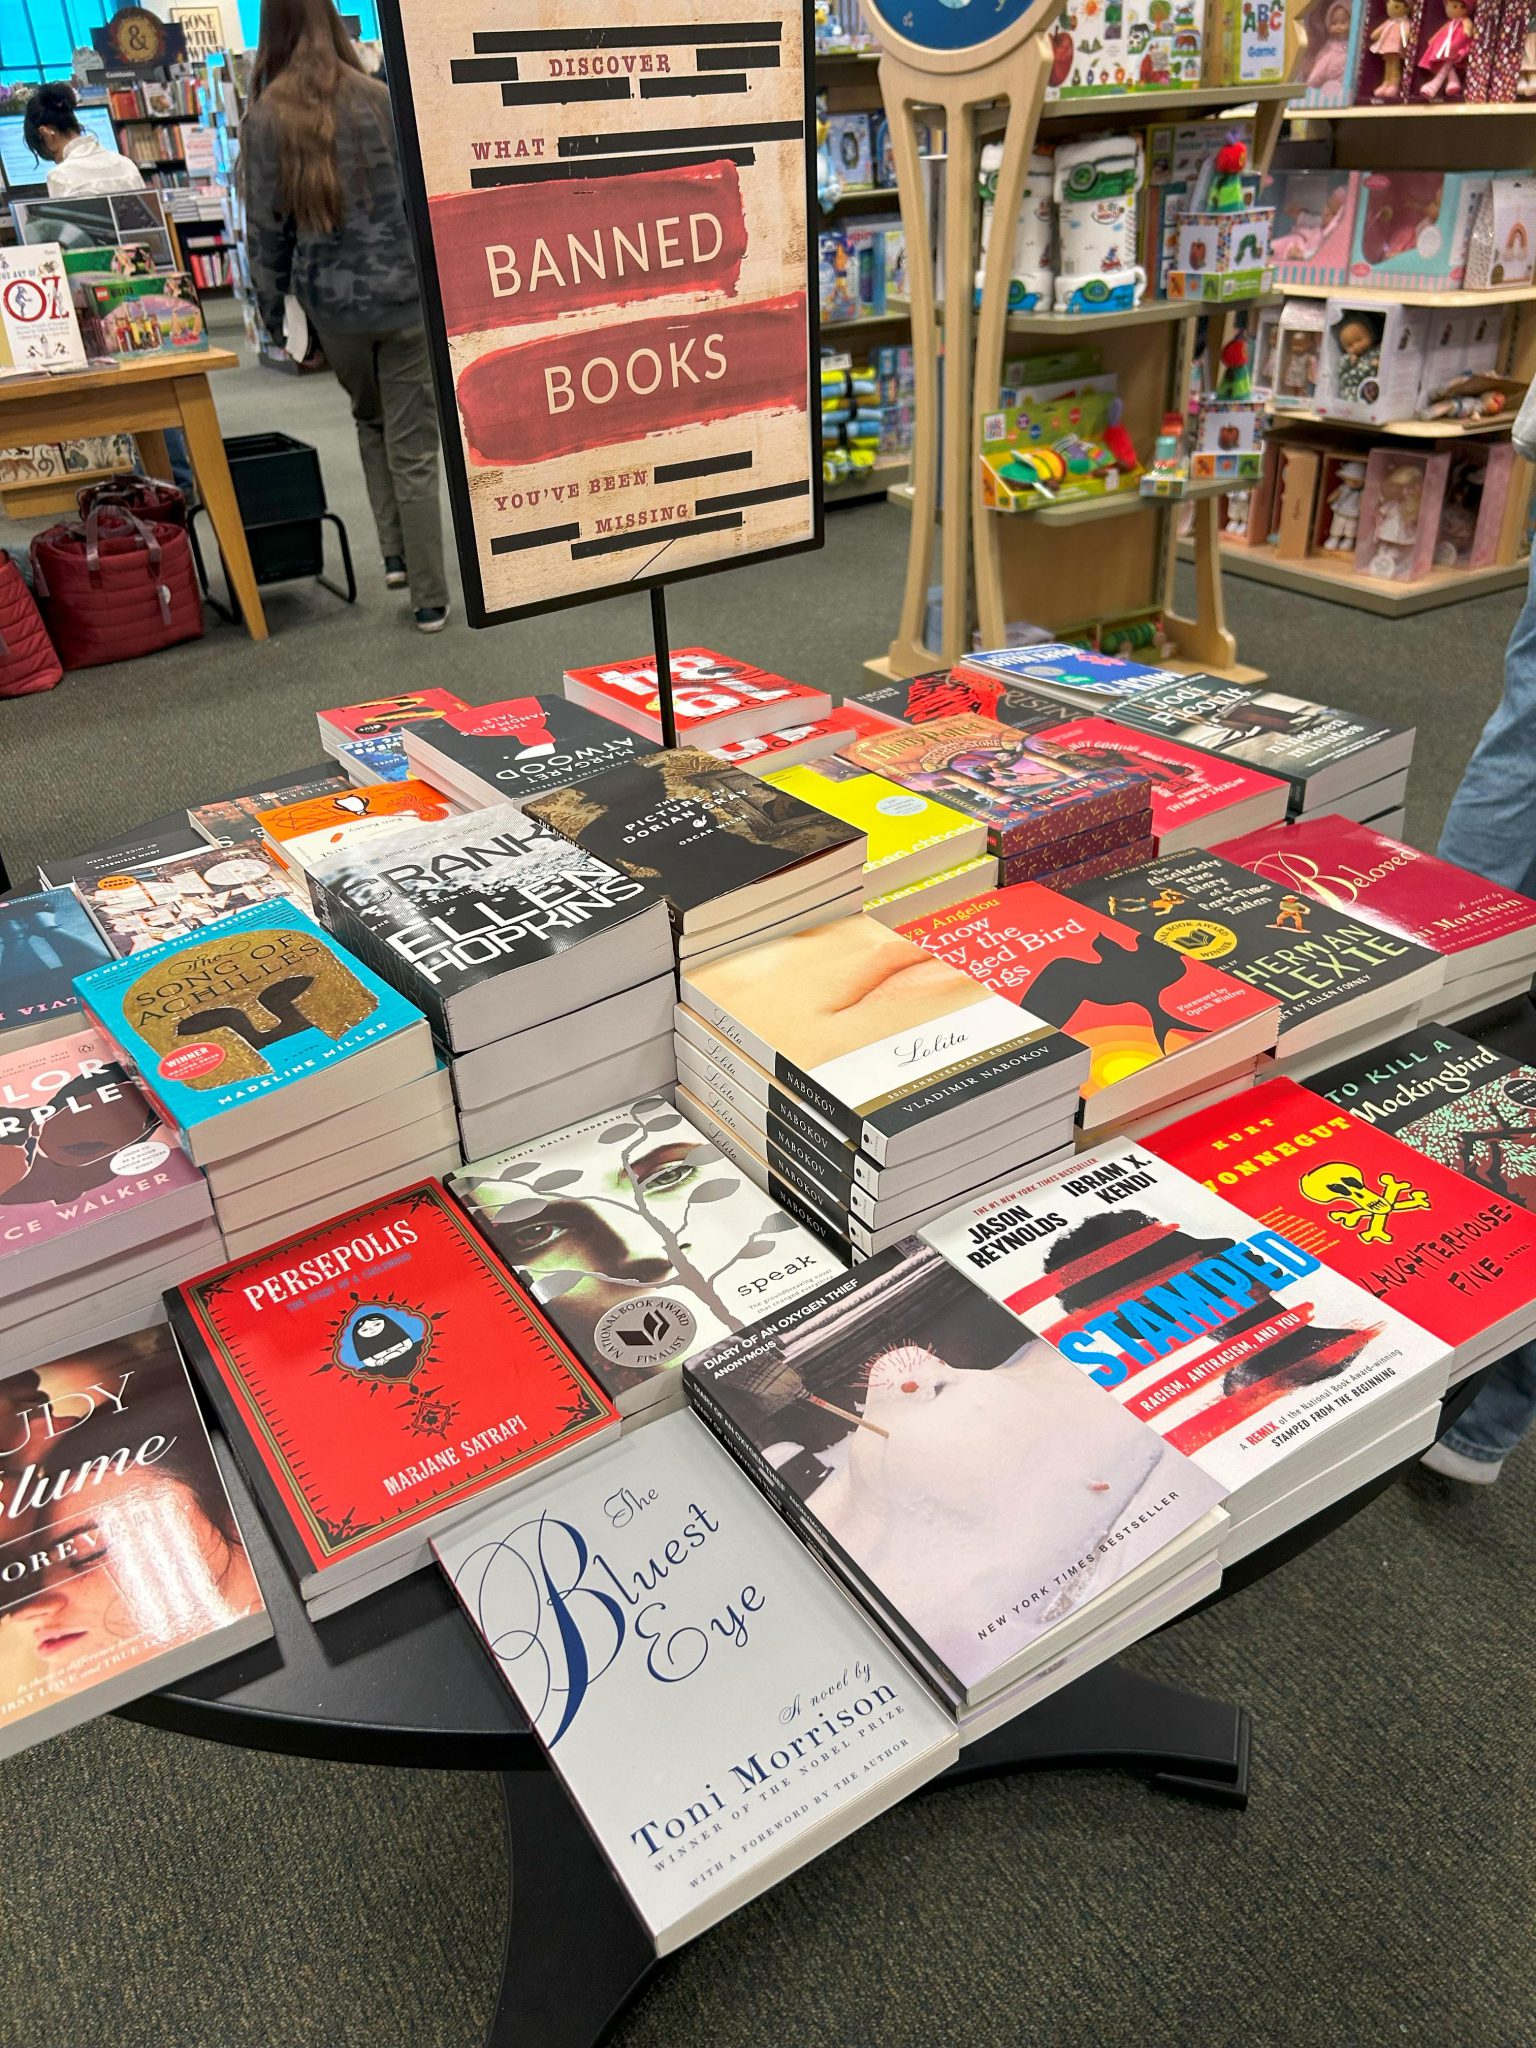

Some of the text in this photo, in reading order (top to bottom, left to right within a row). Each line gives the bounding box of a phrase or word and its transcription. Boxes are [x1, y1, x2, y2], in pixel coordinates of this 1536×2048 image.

[128, 25, 147, 50] &
[550, 54, 670, 77] DISCOVER
[472, 138, 545, 160] WHAT
[484, 213, 723, 298] BANNED
[3, 276, 69, 322] OZ
[544, 333, 728, 415] BOOKS
[494, 470, 648, 512] YOU'VE BEEN
[595, 503, 689, 534] MISSING
[481, 713, 516, 724] TALE
[1145, 685, 1211, 712] Jodi
[1148, 686, 1252, 728] Picoult
[459, 711, 551, 737] HANDMAID'S
[499, 722, 527, 732] THE
[1265, 718, 1349, 755] nineteen
[1286, 723, 1365, 759] minutes
[495, 737, 633, 780] ATWOOD
[526, 748, 635, 783] MARGARET
[622, 788, 750, 845] DORIAN GRAY
[624, 796, 704, 832] PICTURE
[654, 796, 680, 809] THE
[678, 812, 749, 847] OSCAR WILDE
[94, 849, 160, 870] JOHN STEINBECK
[1146, 858, 1224, 887] Absolutely
[1175, 871, 1213, 886] True
[1241, 848, 1421, 911] Beloved
[1189, 878, 1229, 895] Diary
[1198, 883, 1274, 912] Part-Time
[1222, 895, 1273, 916] Indian
[385, 858, 621, 963] ELLEN
[415, 873, 646, 985] HOPKINS
[931, 897, 1001, 930] Angelou
[1431, 899, 1523, 931] Morrison
[103, 960, 129, 974] NEW
[134, 946, 167, 961] YORK
[171, 931, 207, 947] TIMES
[211, 900, 283, 932] BESTSELLER
[913, 915, 991, 952] Know
[986, 925, 1021, 949] the
[1021, 918, 1086, 953] Bird
[1231, 923, 1375, 985] HERMAN
[135, 933, 295, 1007] SONG OF
[168, 940, 252, 977] The
[1263, 937, 1410, 1001] LEXIE
[136, 941, 322, 1029] ACHILLES
[1176, 987, 1228, 1014] Foreword by
[1185, 988, 1246, 1018] Oprah Winfrey
[1307, 974, 1372, 1008] ELLEN FORNEY
[710, 1008, 743, 1044] Lolita
[165, 1047, 209, 1068] WINNER
[217, 1022, 389, 1106] MADELINE MILLER
[704, 1038, 736, 1075] Lolita
[887, 1034, 1033, 1100] 50th ANNIVERSARY EDITION
[894, 1030, 970, 1069] Lolita
[704, 1065, 736, 1102] Lolita
[902, 1044, 1051, 1115] VLADIMIR NABOKOV
[1324, 1039, 1452, 1104] TO KILL A
[1350, 1045, 1500, 1124] Mockingbird
[708, 1091, 736, 1128] Lolita
[787, 1071, 835, 1116] NABOKOV
[496, 1112, 630, 1165] LAURIE HALSE ANDERSON
[709, 1122, 738, 1159] Lolita
[780, 1104, 828, 1149] NABOKOV
[1211, 1117, 1276, 1151] KURT
[778, 1131, 825, 1176] NABOKOV
[1201, 1116, 1353, 1195] VONNEGUT
[56, 1172, 171, 1221] WALKER
[778, 1159, 824, 1206] NABOKOV
[972, 1156, 1100, 1217] THE #1 NEW YORK TIMES BESTSELLER
[1061, 1153, 1152, 1198] IBRAM X.
[1094, 1171, 1159, 1205] KENDI
[780, 1191, 827, 1237] NABOKOV
[967, 1204, 1034, 1245] JASON
[966, 1212, 1068, 1269] REYNOLDS
[1358, 1203, 1513, 1299] LAUGHTERHOUSE-
[241, 1219, 419, 1313] PERSEPOLIS
[737, 1254, 818, 1298] speak
[1448, 1256, 1505, 1297] FIVE
[599, 1298, 691, 1361] NATIONAL BOOK AWARD
[703, 1278, 859, 1371] DIARY OF AN OXYGEN THIEF
[1058, 1229, 1322, 1388] STAMPED
[636, 1334, 686, 1365] FINALIST
[713, 1340, 777, 1380] ANONYMOUS
[1139, 1312, 1302, 1414] RACISM, ANTIRACISM, AND YOU
[1238, 1347, 1403, 1451] A REMIX of the National Book Award-winning
[1270, 1367, 1397, 1449] STAMPED FROM THE BEGINNING
[382, 1414, 529, 1497] MARJANE SATRAPI
[602, 1487, 659, 1529] The
[977, 1491, 1180, 1640] NEW YORK TIMES BESTSELLER
[454, 1502, 721, 1751] Bluest
[634, 1584, 766, 1684] Eye
[777, 1659, 873, 1725] A novel by
[630, 1681, 899, 1860] Toni Morrison
[655, 1704, 906, 1873] WINNER OF THE NOBEL PRIZE
[688, 1736, 911, 1889] WITH A FOREWORD BY THE AUTHOR
